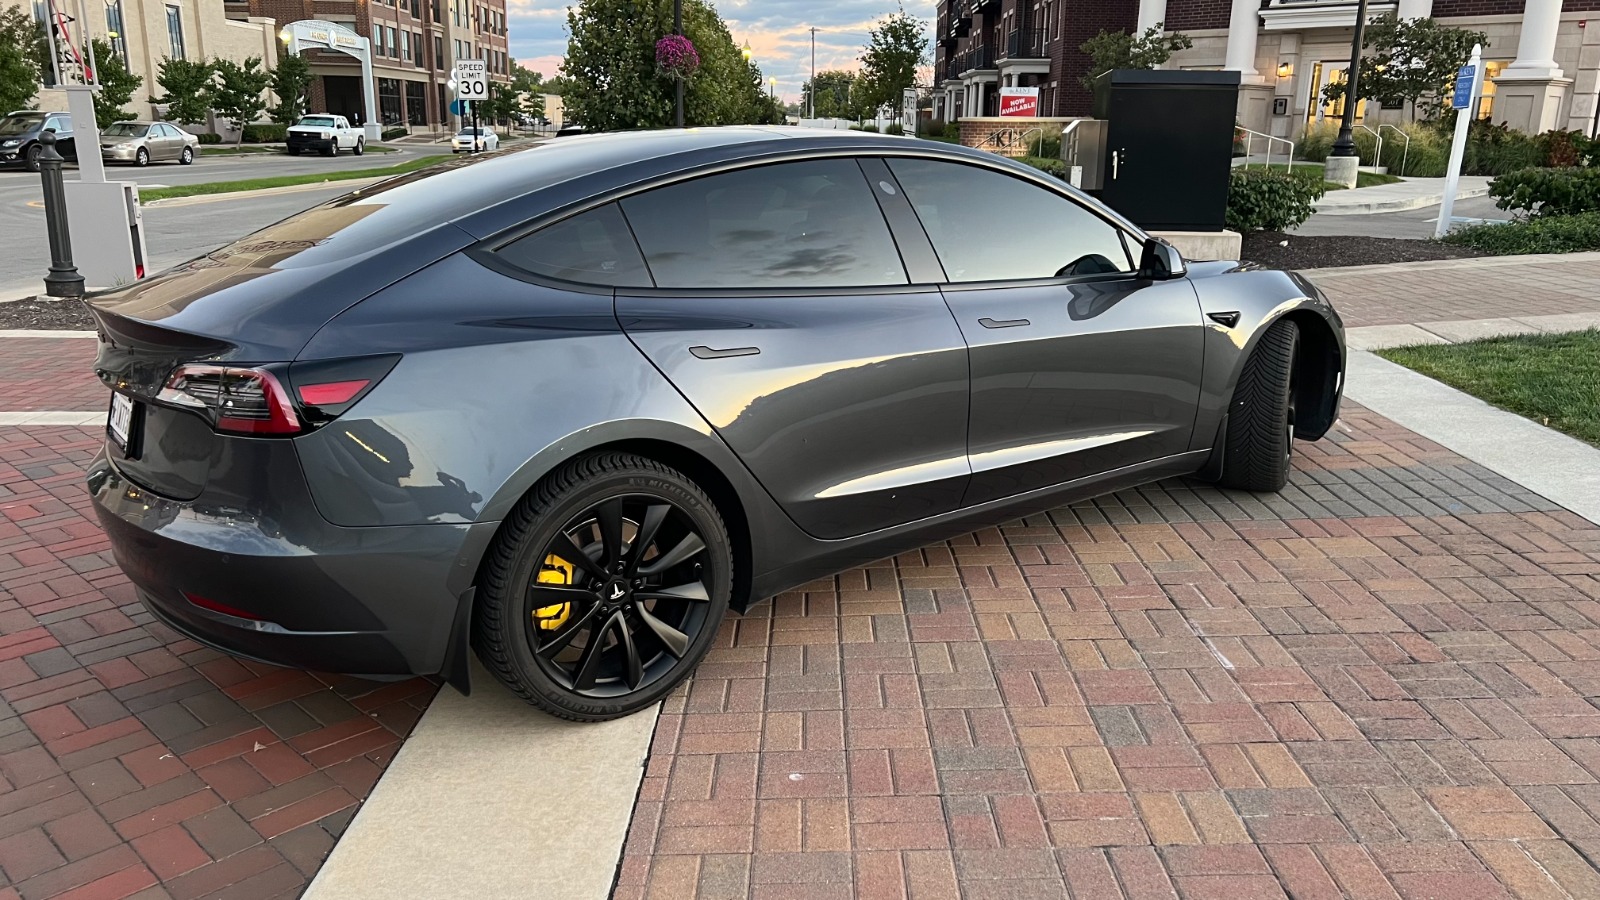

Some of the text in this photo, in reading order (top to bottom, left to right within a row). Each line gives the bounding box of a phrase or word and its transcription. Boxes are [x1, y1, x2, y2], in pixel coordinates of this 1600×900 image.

[460, 80, 484, 95] 30
[1001, 101, 1036, 116] AVAILABLE
[1010, 98, 1026, 107] NOW
[648, 479, 697, 505] MICHELIN
